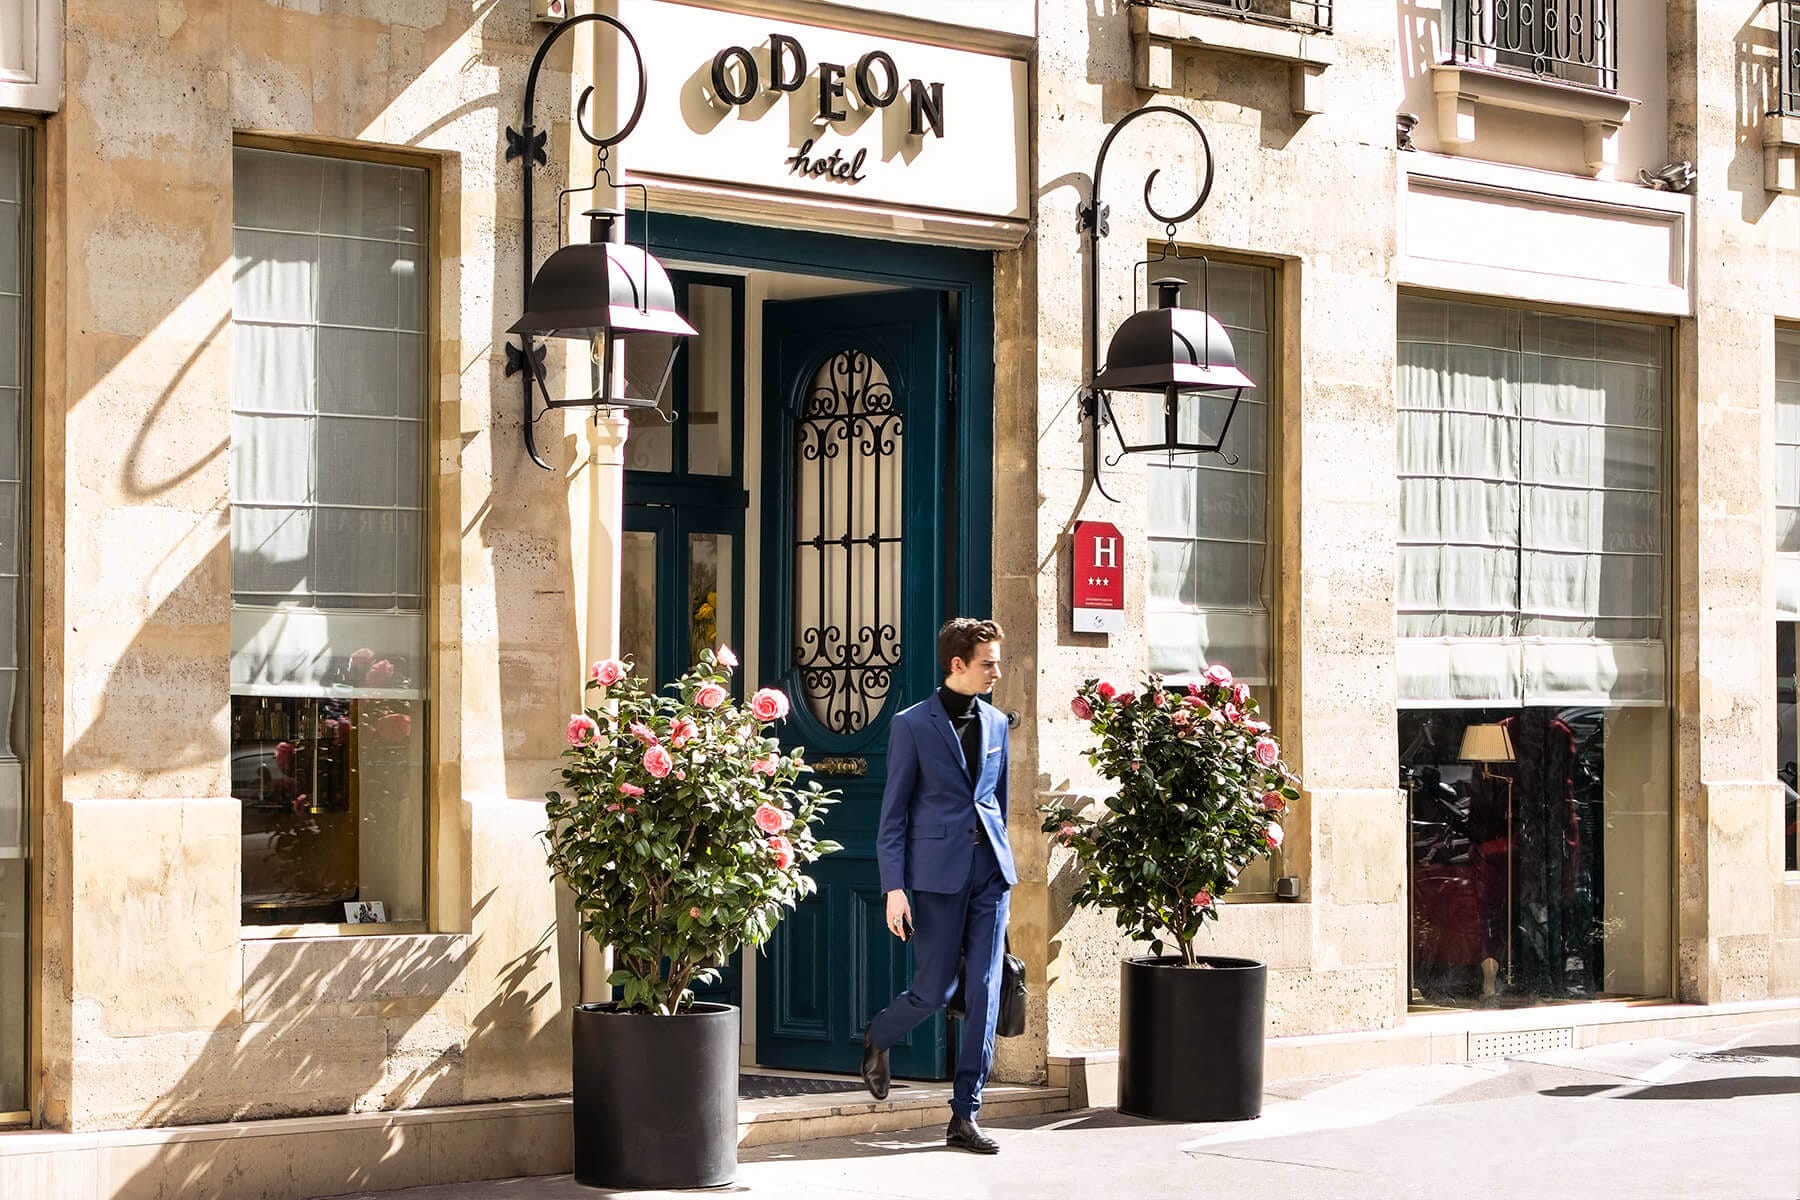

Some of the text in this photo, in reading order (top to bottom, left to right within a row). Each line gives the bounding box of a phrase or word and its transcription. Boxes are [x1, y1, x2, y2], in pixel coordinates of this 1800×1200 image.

[711, 33, 945, 138] ODEON
[788, 139, 867, 182] hotel
[1093, 536, 1118, 568] H
